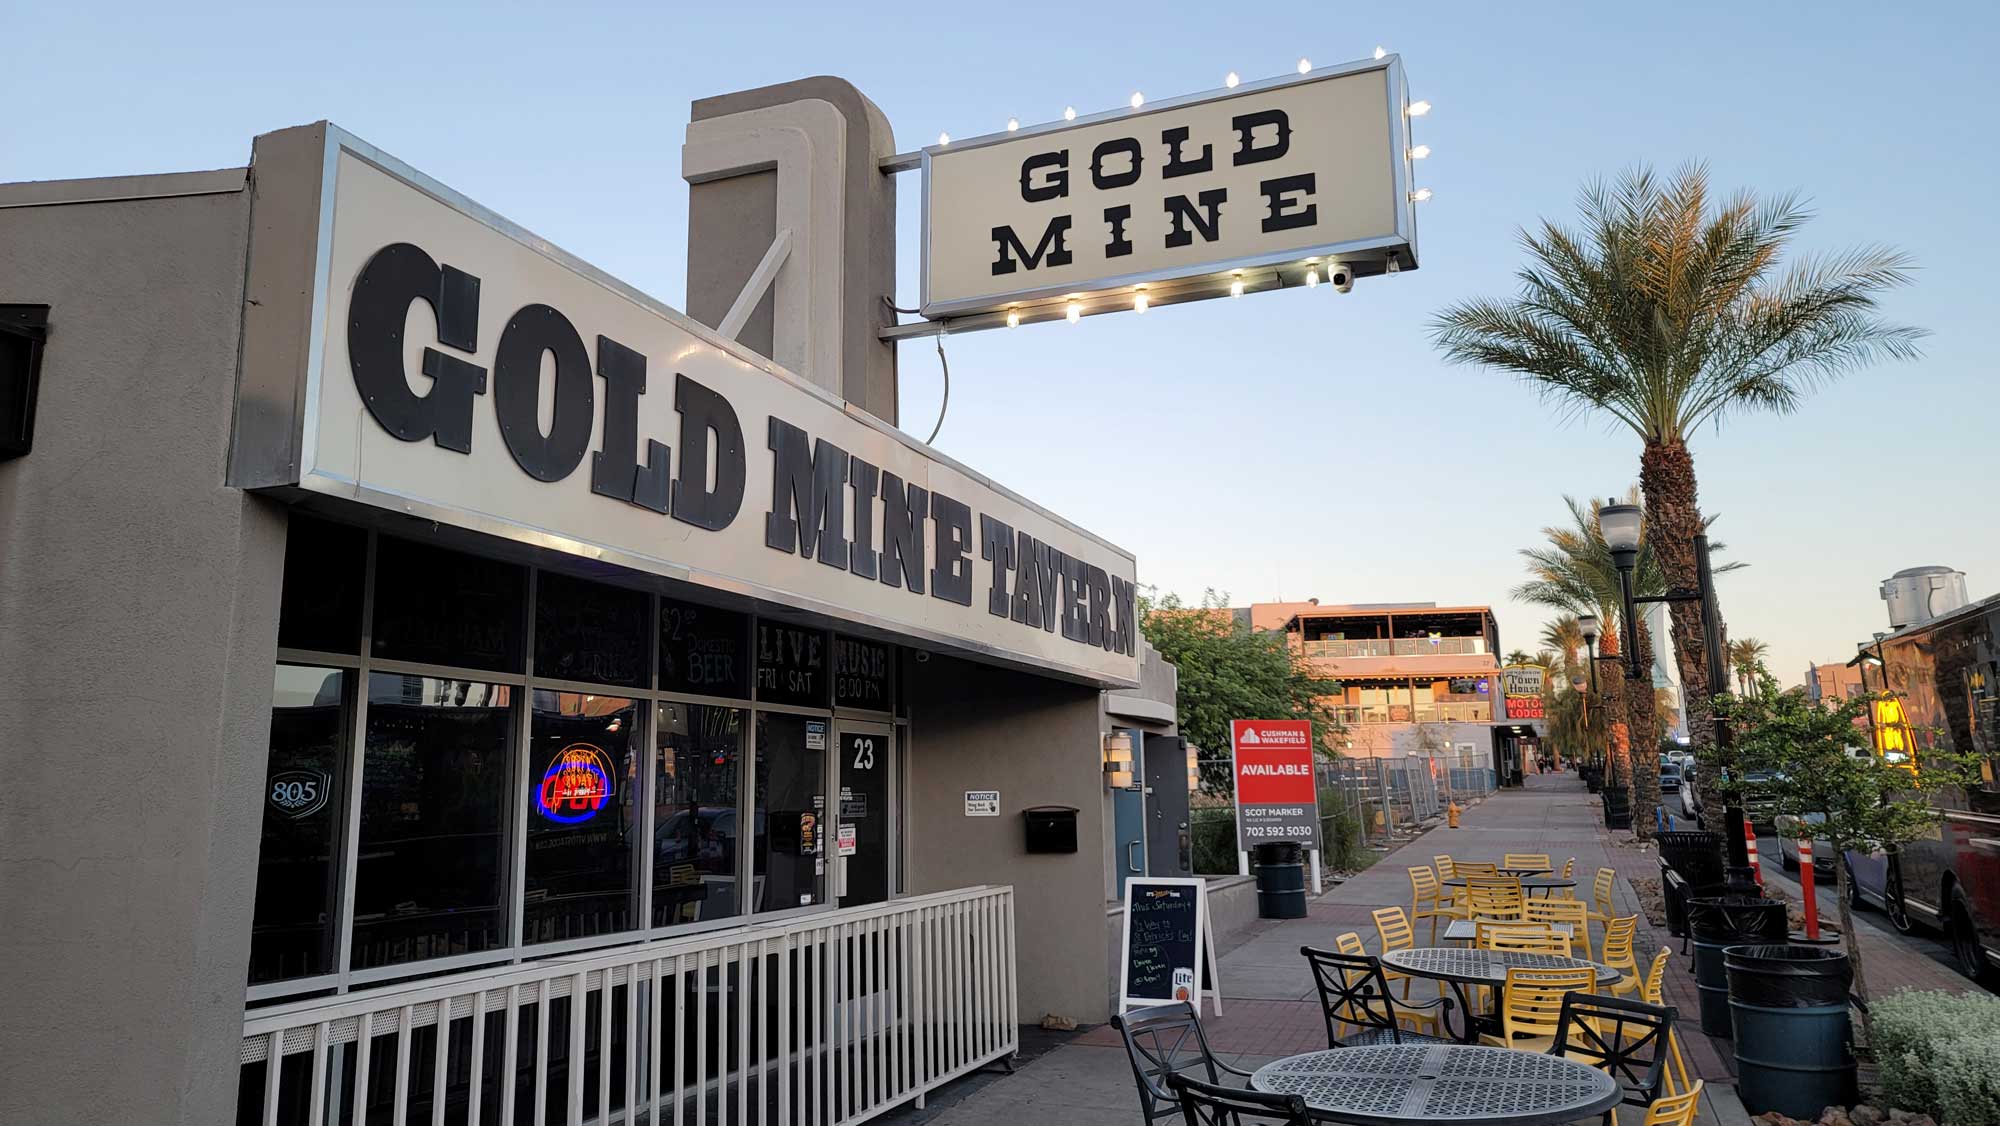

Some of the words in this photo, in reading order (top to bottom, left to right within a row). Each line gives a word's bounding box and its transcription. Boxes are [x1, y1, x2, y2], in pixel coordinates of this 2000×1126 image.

[1019, 109, 1293, 203] GOLD
[991, 173, 1318, 275] MINE
[347, 242, 746, 532] GOLD
[765, 415, 973, 607] MINE
[980, 512, 1135, 657] TAVERN
[760, 626, 820, 668] LIVE
[832, 640, 885, 680] MUSIC
[687, 653, 736, 684] BEER
[758, 668, 776, 689] FRI
[788, 669, 812, 694] SAT
[1505, 675, 1540, 684] Town
[864, 680, 880, 700] PM
[1509, 709, 1545, 719] LODGE
[853, 738, 874, 770] 23
[1241, 764, 1309, 776] AVAILABLE
[272, 782, 317, 802] 805
[1245, 808, 1267, 817] SCOT
[1269, 808, 1304, 816] MARKER
[1246, 827, 1265, 837] 702
[1266, 826, 1285, 836] 592
[1287, 826, 1312, 836] 5030
[1175, 972, 1192, 985] Lite
